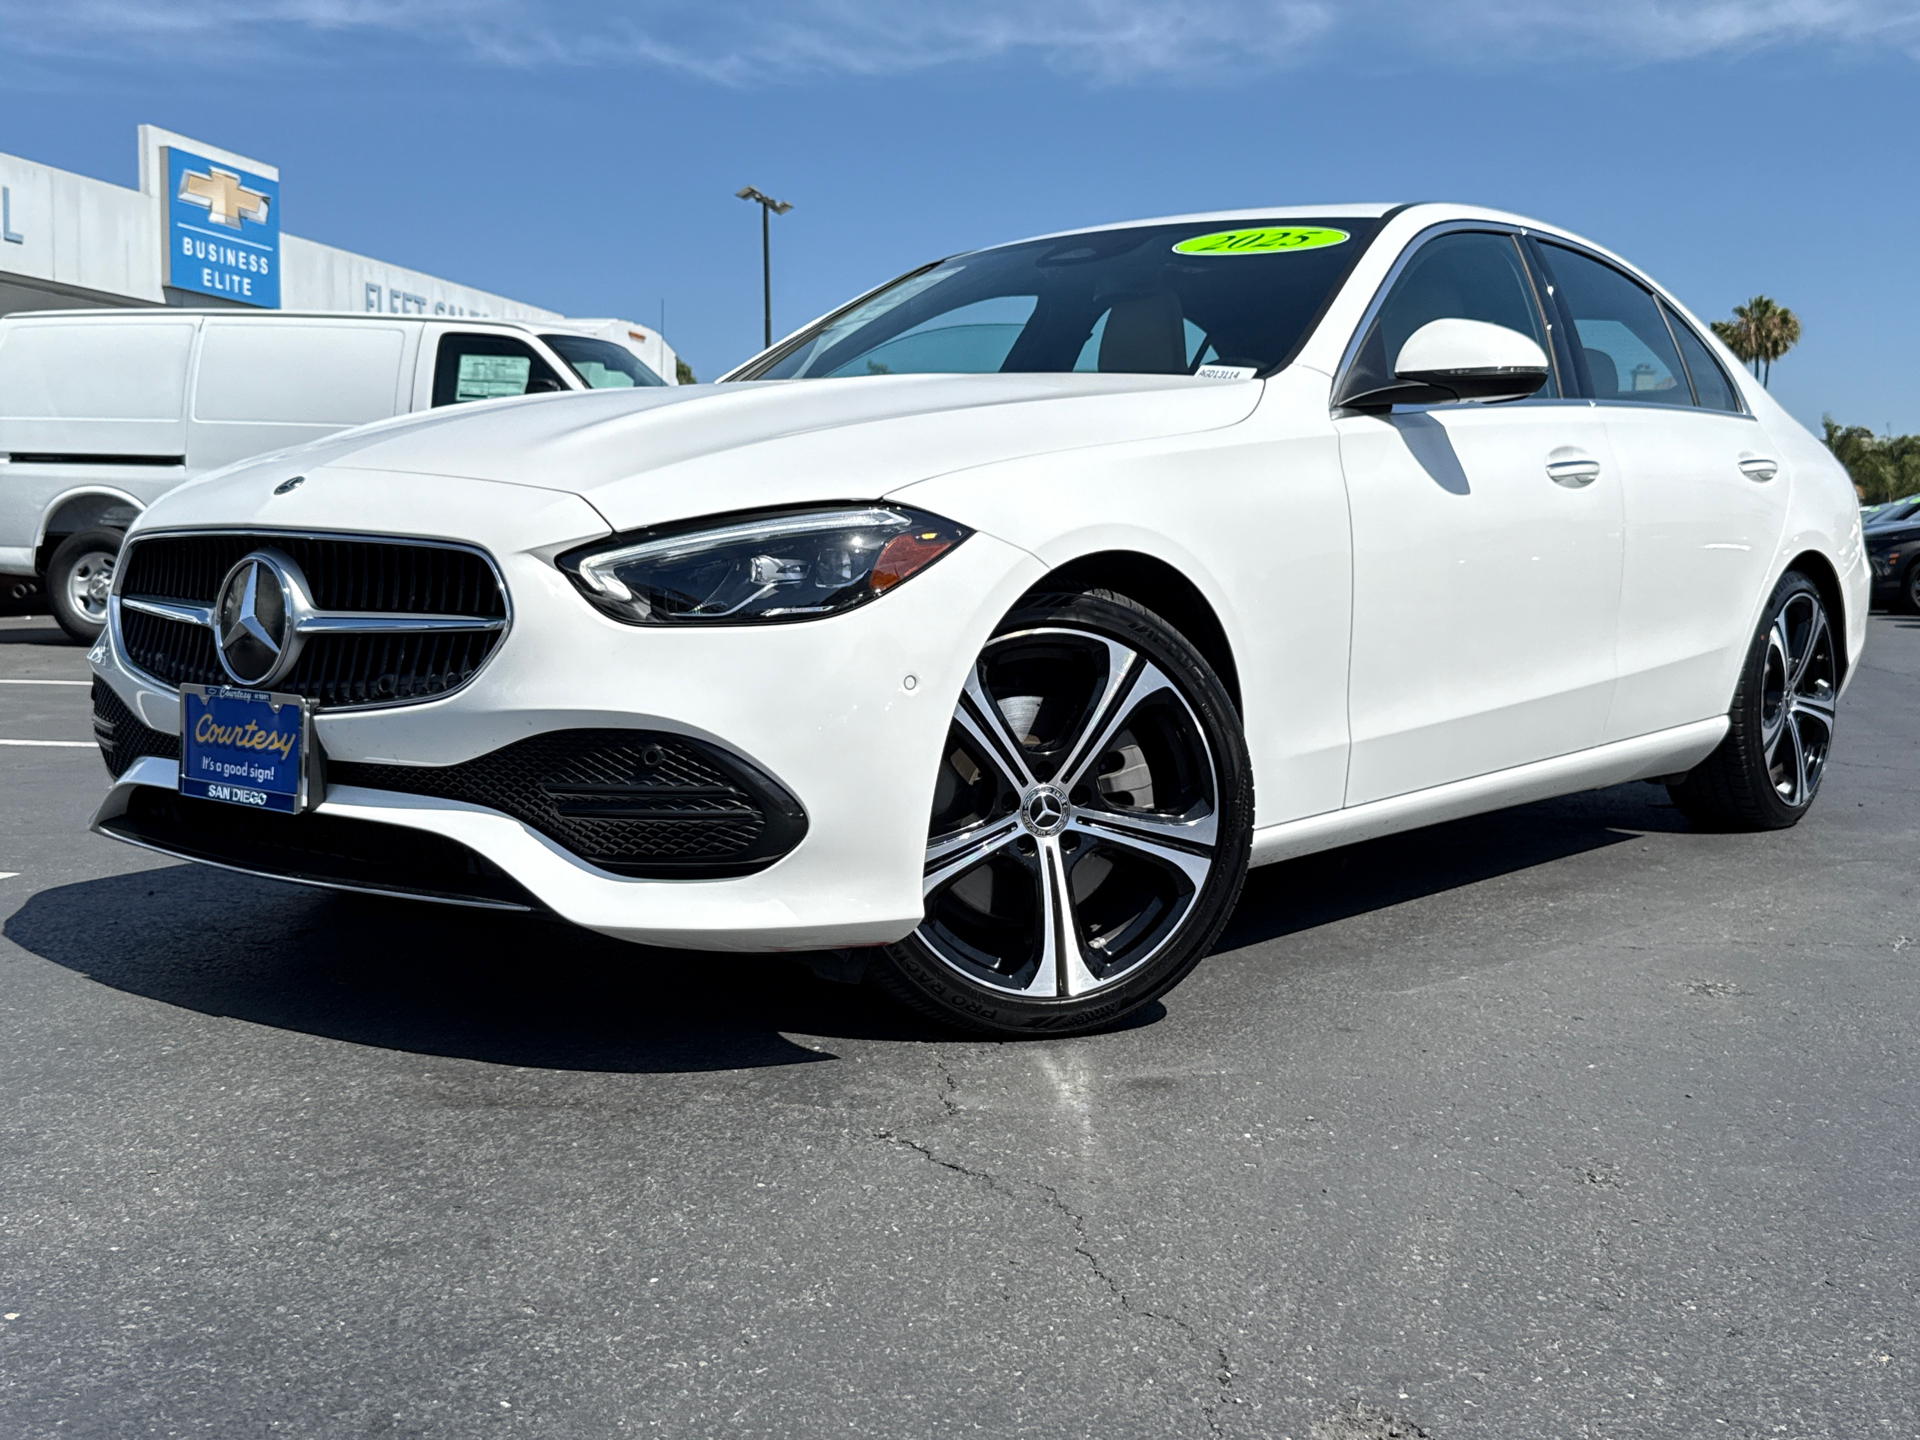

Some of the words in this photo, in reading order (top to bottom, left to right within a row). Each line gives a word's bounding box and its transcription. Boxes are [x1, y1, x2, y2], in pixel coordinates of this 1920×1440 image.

[1196, 232, 1321, 251] 2025
[183, 237, 269, 275] BUSINESS
[203, 268, 252, 296] ELITE
[195, 714, 296, 760] Courtesy
[202, 756, 215, 771] It's
[216, 762, 222, 772] a
[224, 762, 248, 777] good
[250, 764, 275, 783] sign!
[208, 785, 230, 800] SAN
[232, 790, 267, 806] DIEGO
[889, 944, 948, 996] RACIN
[951, 995, 999, 1020] PRO
